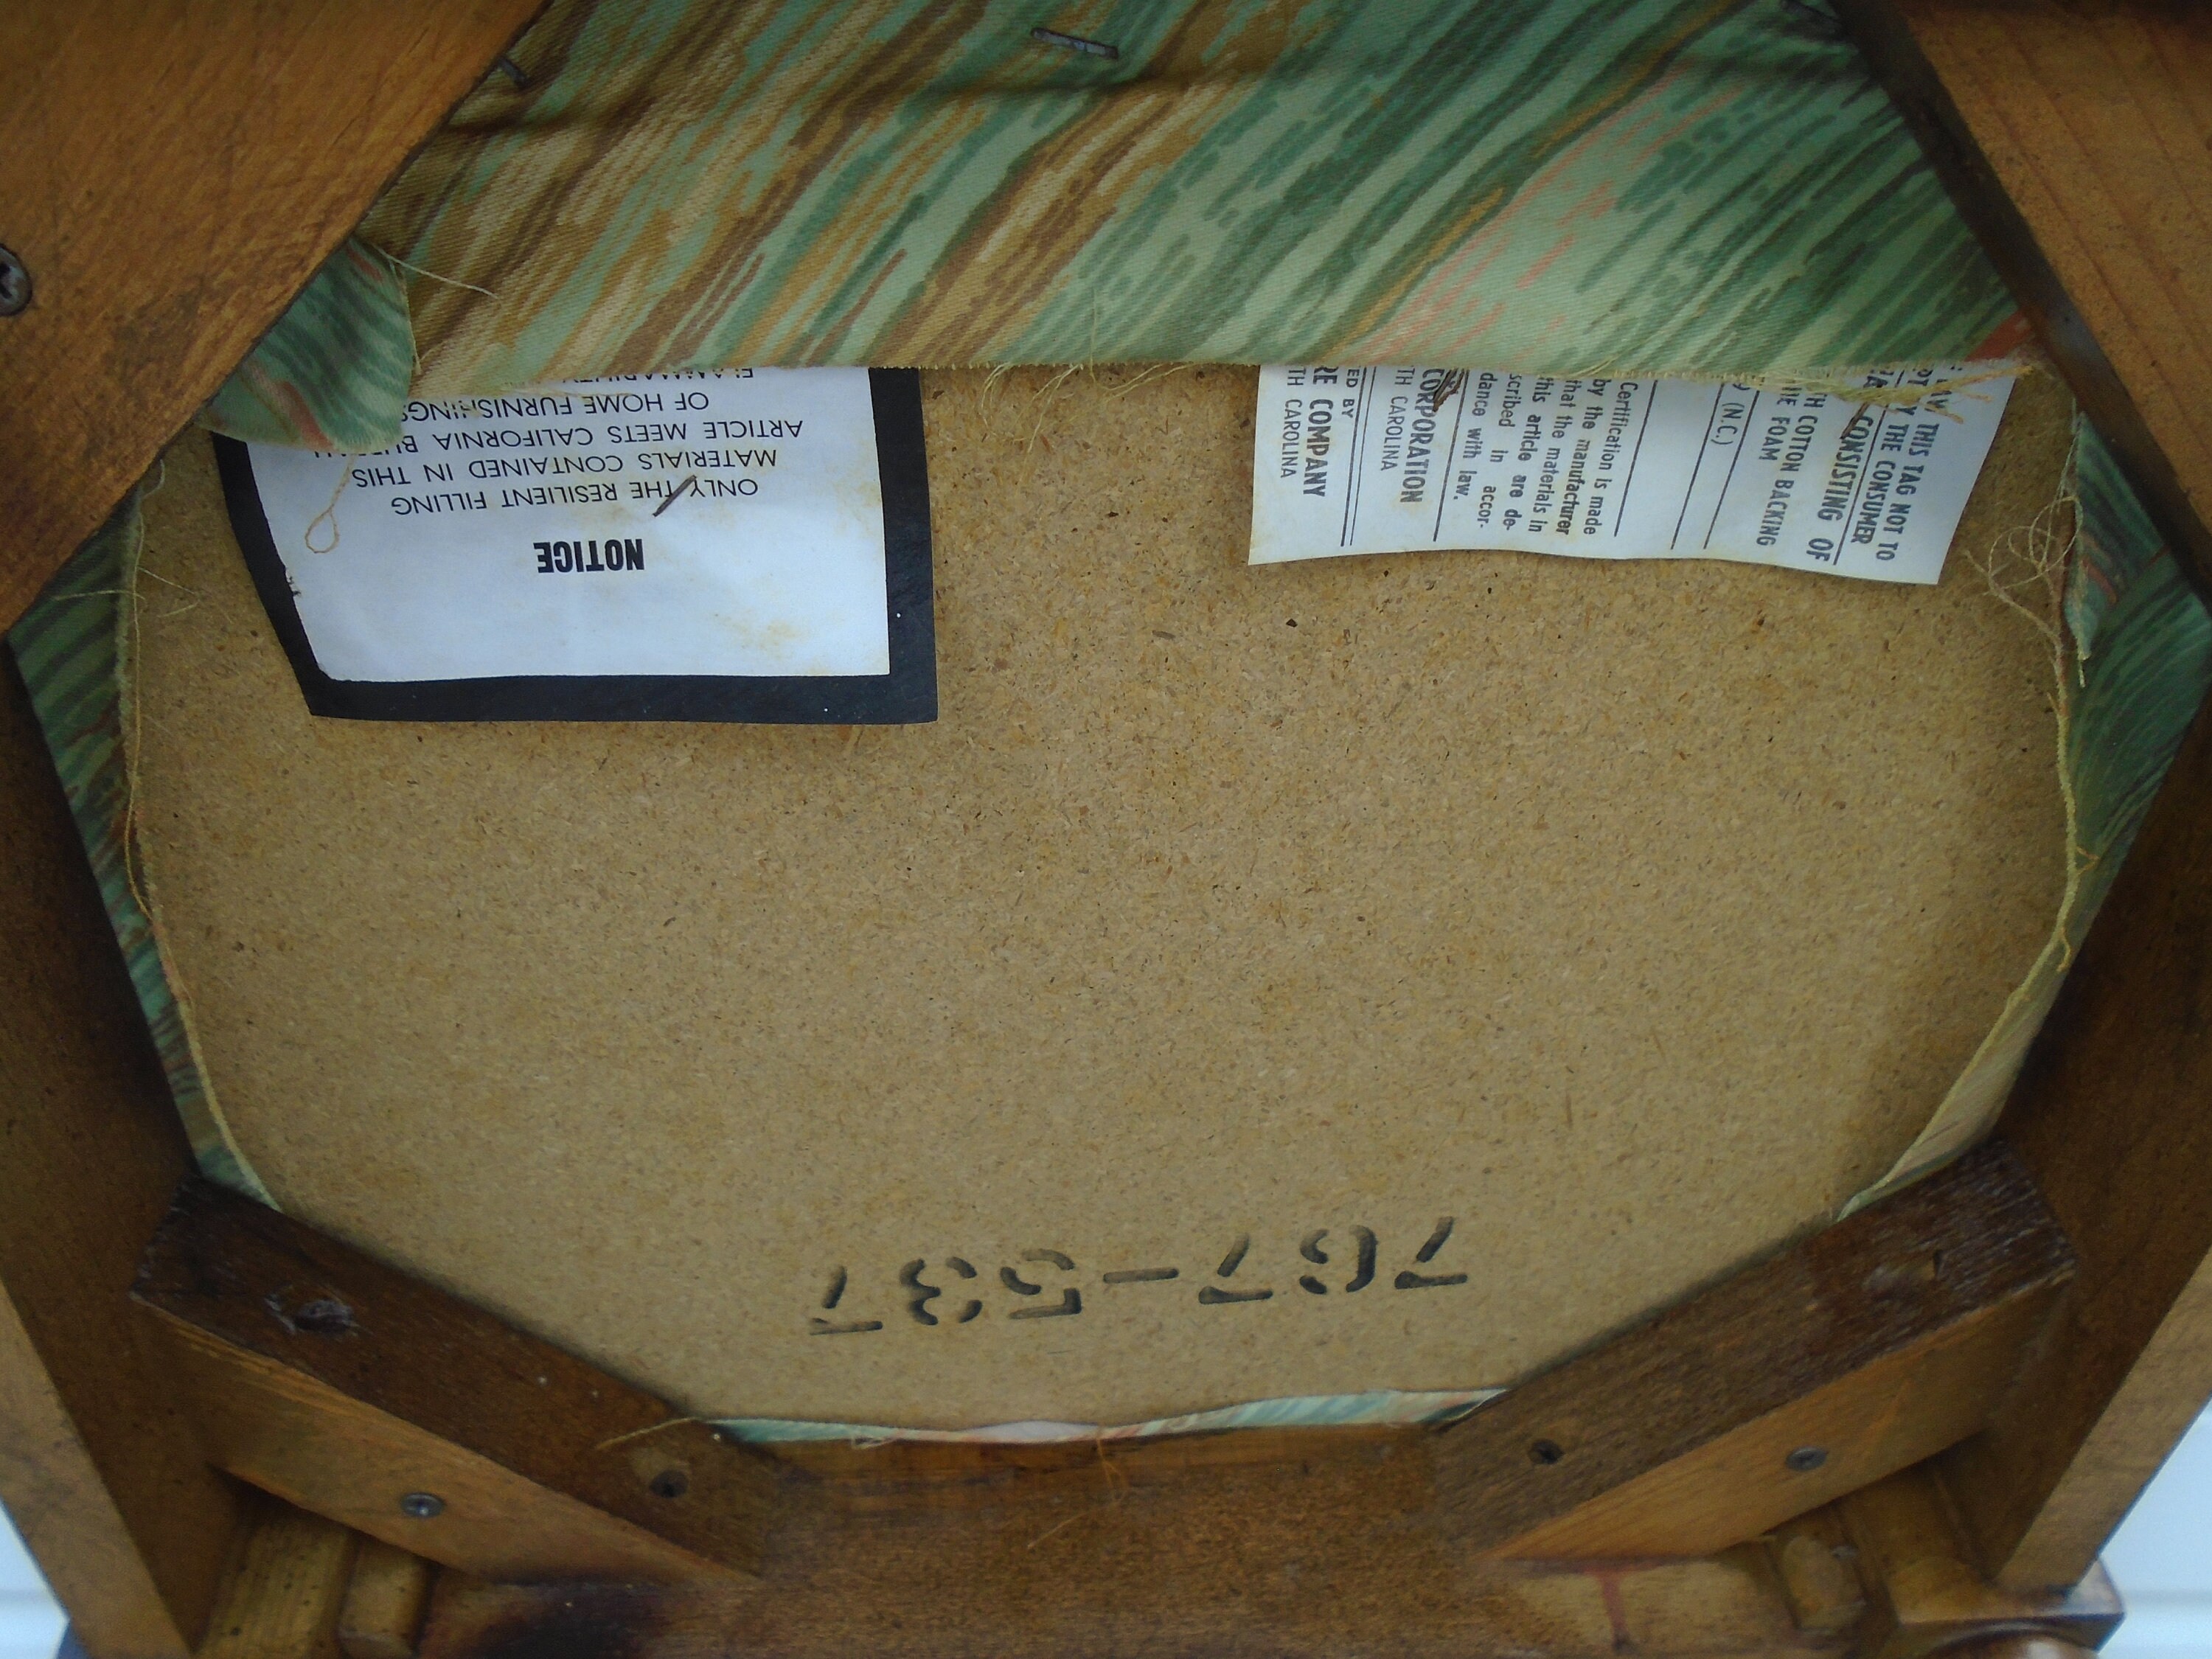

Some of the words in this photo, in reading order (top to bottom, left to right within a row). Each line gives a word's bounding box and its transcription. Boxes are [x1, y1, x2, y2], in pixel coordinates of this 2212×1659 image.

[674, 391, 710, 411] OF
[1472, 372, 1498, 417] dance
[1498, 373, 1523, 428] scribed
[1560, 379, 1582, 408] that
[1587, 378, 1612, 397] by
[585, 393, 663, 414] HOME
[1340, 398, 1355, 420] BY
[1582, 406, 1604, 430] the
[432, 426, 594, 451] CALIFORNIA
[609, 422, 686, 443] MEETS
[704, 419, 804, 439] ARTICLE
[1380, 395, 1409, 472] CAROLINA
[1399, 368, 1443, 504] CORPORATION
[1517, 414, 1542, 462] article
[1551, 414, 1573, 439] the
[1599, 381, 1638, 470] Certification
[1711, 402, 1745, 446] (N.C.)
[1880, 423, 1910, 452] THE
[1280, 399, 1303, 479] CAROLINA
[1302, 398, 1334, 498] COMPANY
[1462, 427, 1484, 459] with
[1759, 417, 1791, 462] FOAM
[1780, 414, 1819, 472] COTTON
[1908, 422, 1939, 457] THIS
[469, 453, 623, 479] CONTAINED
[639, 448, 777, 470] MATERIALS
[1489, 449, 1509, 463] in
[1817, 415, 1874, 521] CONSISTING
[352, 466, 411, 489] THIS
[423, 464, 453, 483] IN
[689, 478, 759, 498] ONLY
[1453, 470, 1478, 501] law.
[1509, 474, 1527, 498] are
[1533, 446, 1561, 515] materials
[1556, 439, 1591, 536] manufacturer
[1594, 477, 1613, 490] is
[1896, 465, 1924, 495] TAG
[390, 490, 487, 515] FILLING
[501, 481, 617, 508] RESILIENT
[631, 480, 675, 501] THE
[1850, 459, 1896, 545] CONSUMER
[1477, 484, 1497, 529] accor-
[1503, 508, 1523, 531] de-
[1583, 495, 1604, 535] made
[1756, 479, 1795, 546] BACKING
[1883, 502, 1912, 535] NOT
[1528, 518, 1548, 533] in
[533, 538, 645, 574] NOTICE
[1806, 538, 1834, 562] OF
[1875, 541, 1899, 561] TO
[809, 1216, 1469, 1336] 767-537
